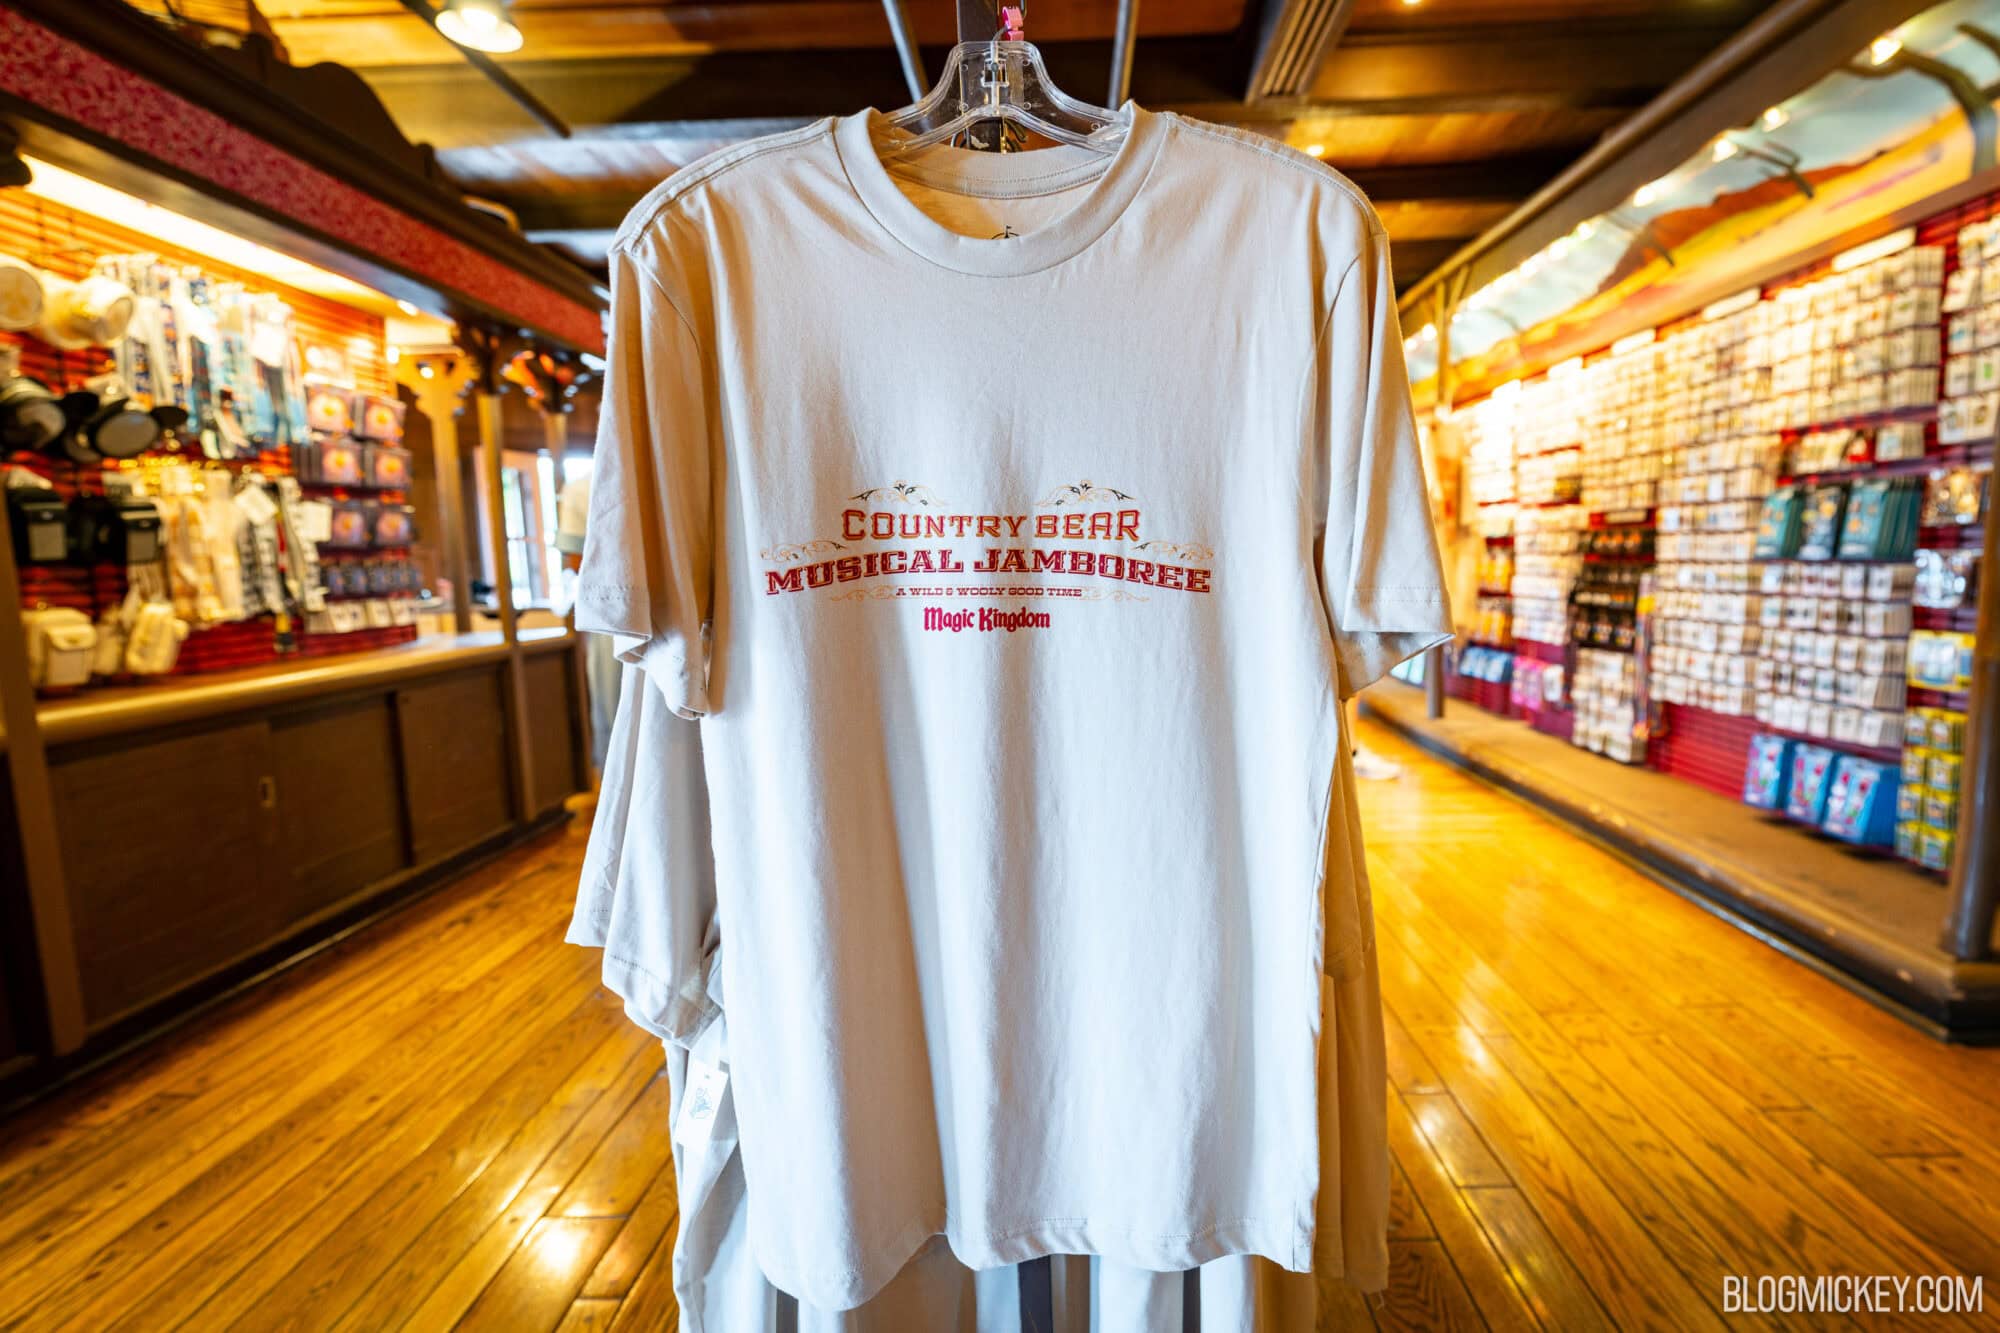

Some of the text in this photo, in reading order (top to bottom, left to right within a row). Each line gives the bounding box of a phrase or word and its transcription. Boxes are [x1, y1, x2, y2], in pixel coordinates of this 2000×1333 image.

[841, 509, 1140, 541] COUNTRY BEAR
[764, 549, 1211, 596] MUSICAL JAMBOREE
[895, 587, 907, 596] A
[909, 587, 944, 596] WILD
[956, 587, 1007, 596] WOOLY
[1008, 587, 1044, 596] GOOD
[1046, 587, 1082, 597] TIME
[923, 605, 1050, 633] Magic Kingdom
